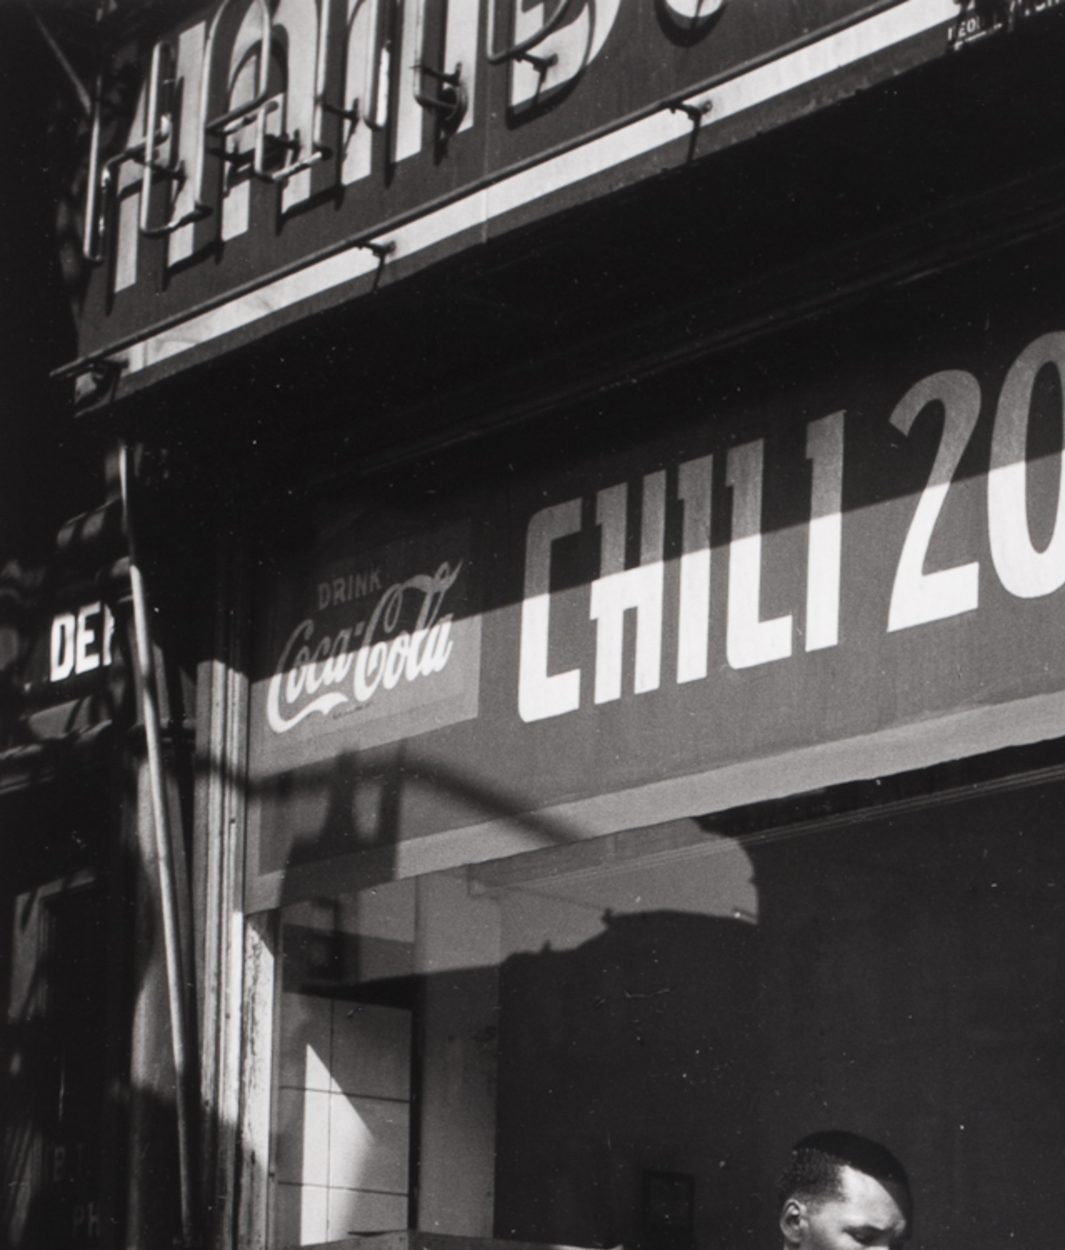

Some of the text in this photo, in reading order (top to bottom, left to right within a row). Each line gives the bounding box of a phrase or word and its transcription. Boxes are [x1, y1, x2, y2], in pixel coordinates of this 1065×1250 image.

[266, 556, 463, 734] Coca-Cola
[316, 564, 382, 611] DRINK
[517, 409, 847, 723] CHILI
